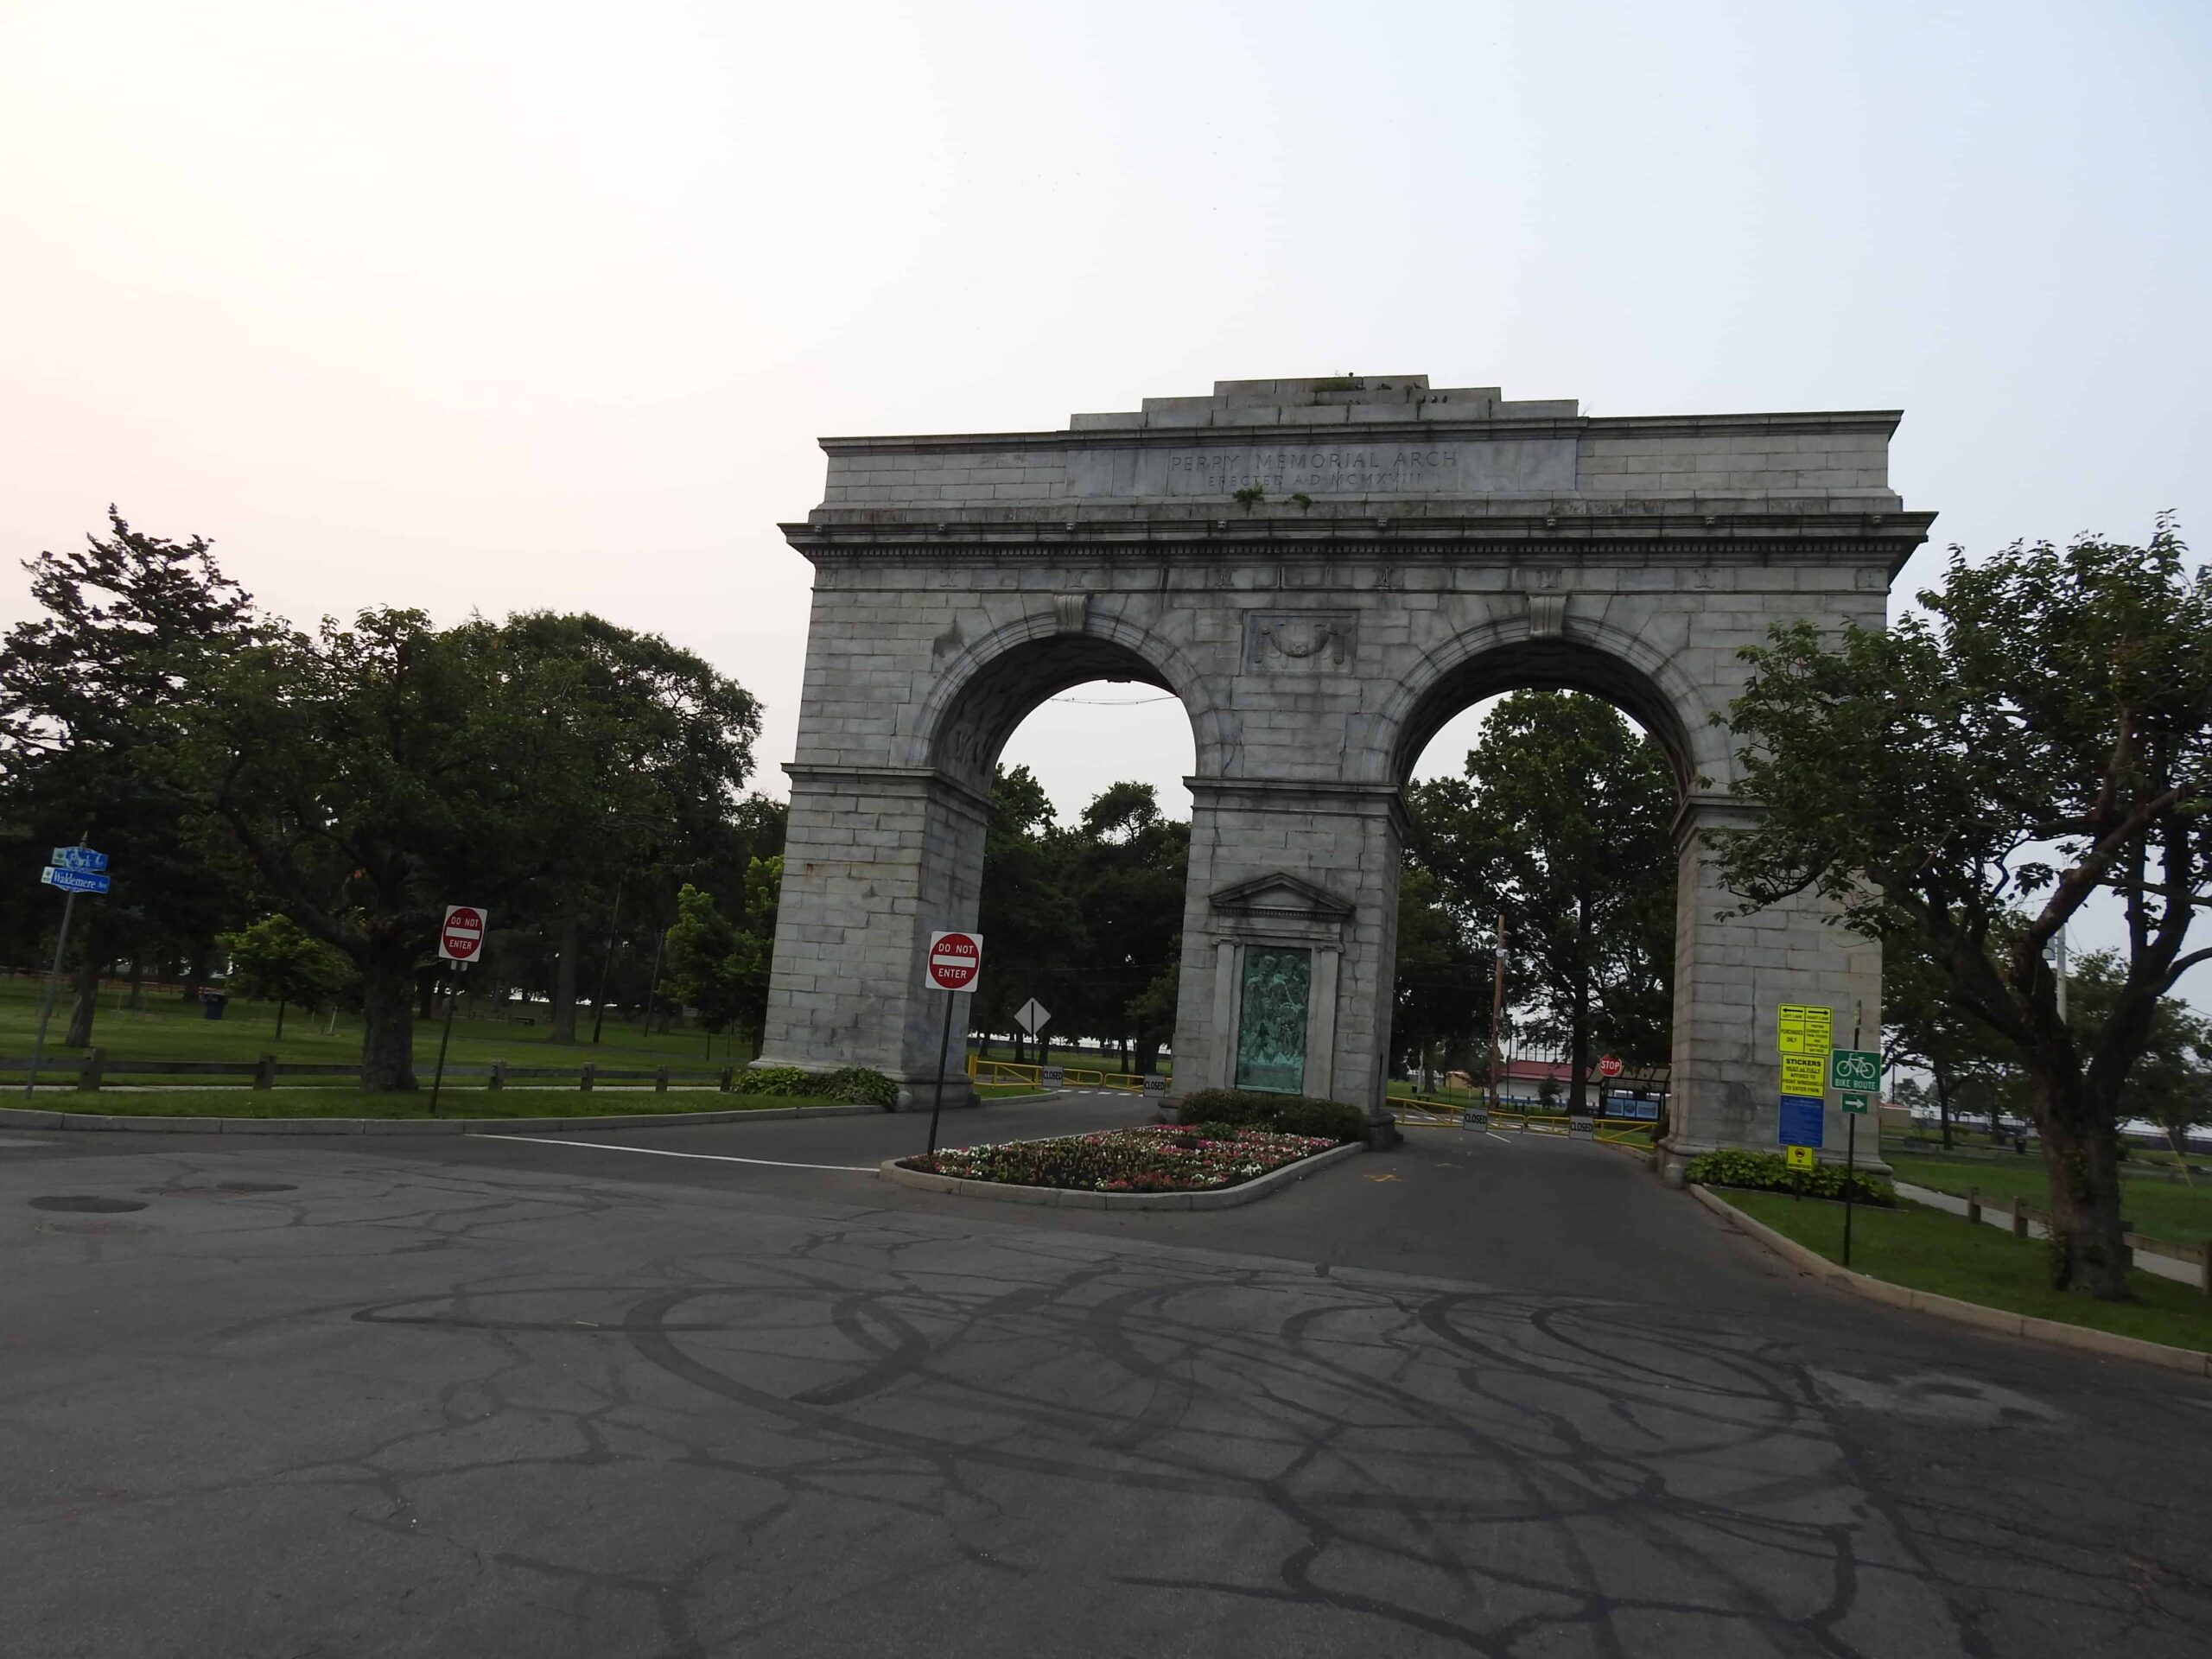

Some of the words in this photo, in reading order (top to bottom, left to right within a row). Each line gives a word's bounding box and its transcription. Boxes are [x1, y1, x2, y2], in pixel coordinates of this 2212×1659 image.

[1171, 454, 1241, 471] PERRY
[1255, 452, 1380, 469] MEMORIAL
[1393, 450, 1457, 467] ARCH
[1208, 475, 1283, 487] ERECTED
[54, 870, 97, 889] Waldemere
[450, 917, 461, 925] DO
[464, 918, 480, 927] NOT
[449, 939, 473, 950] ENTER
[938, 943, 950, 952] DO
[956, 944, 975, 954] NOT
[938, 968, 967, 979] ENTER
[1600, 1059, 1620, 1071] STOP
[1786, 1058, 1821, 1067] STICKERS
[1043, 1070, 1063, 1080] CLOSED
[1145, 1081, 1165, 1091] CLOSED
[1834, 1077, 1851, 1088] BIKE
[1853, 1079, 1876, 1090] ROUTE
[1465, 1113, 1487, 1124] CLOSED
[1570, 1122, 1592, 1133] CLOSED
